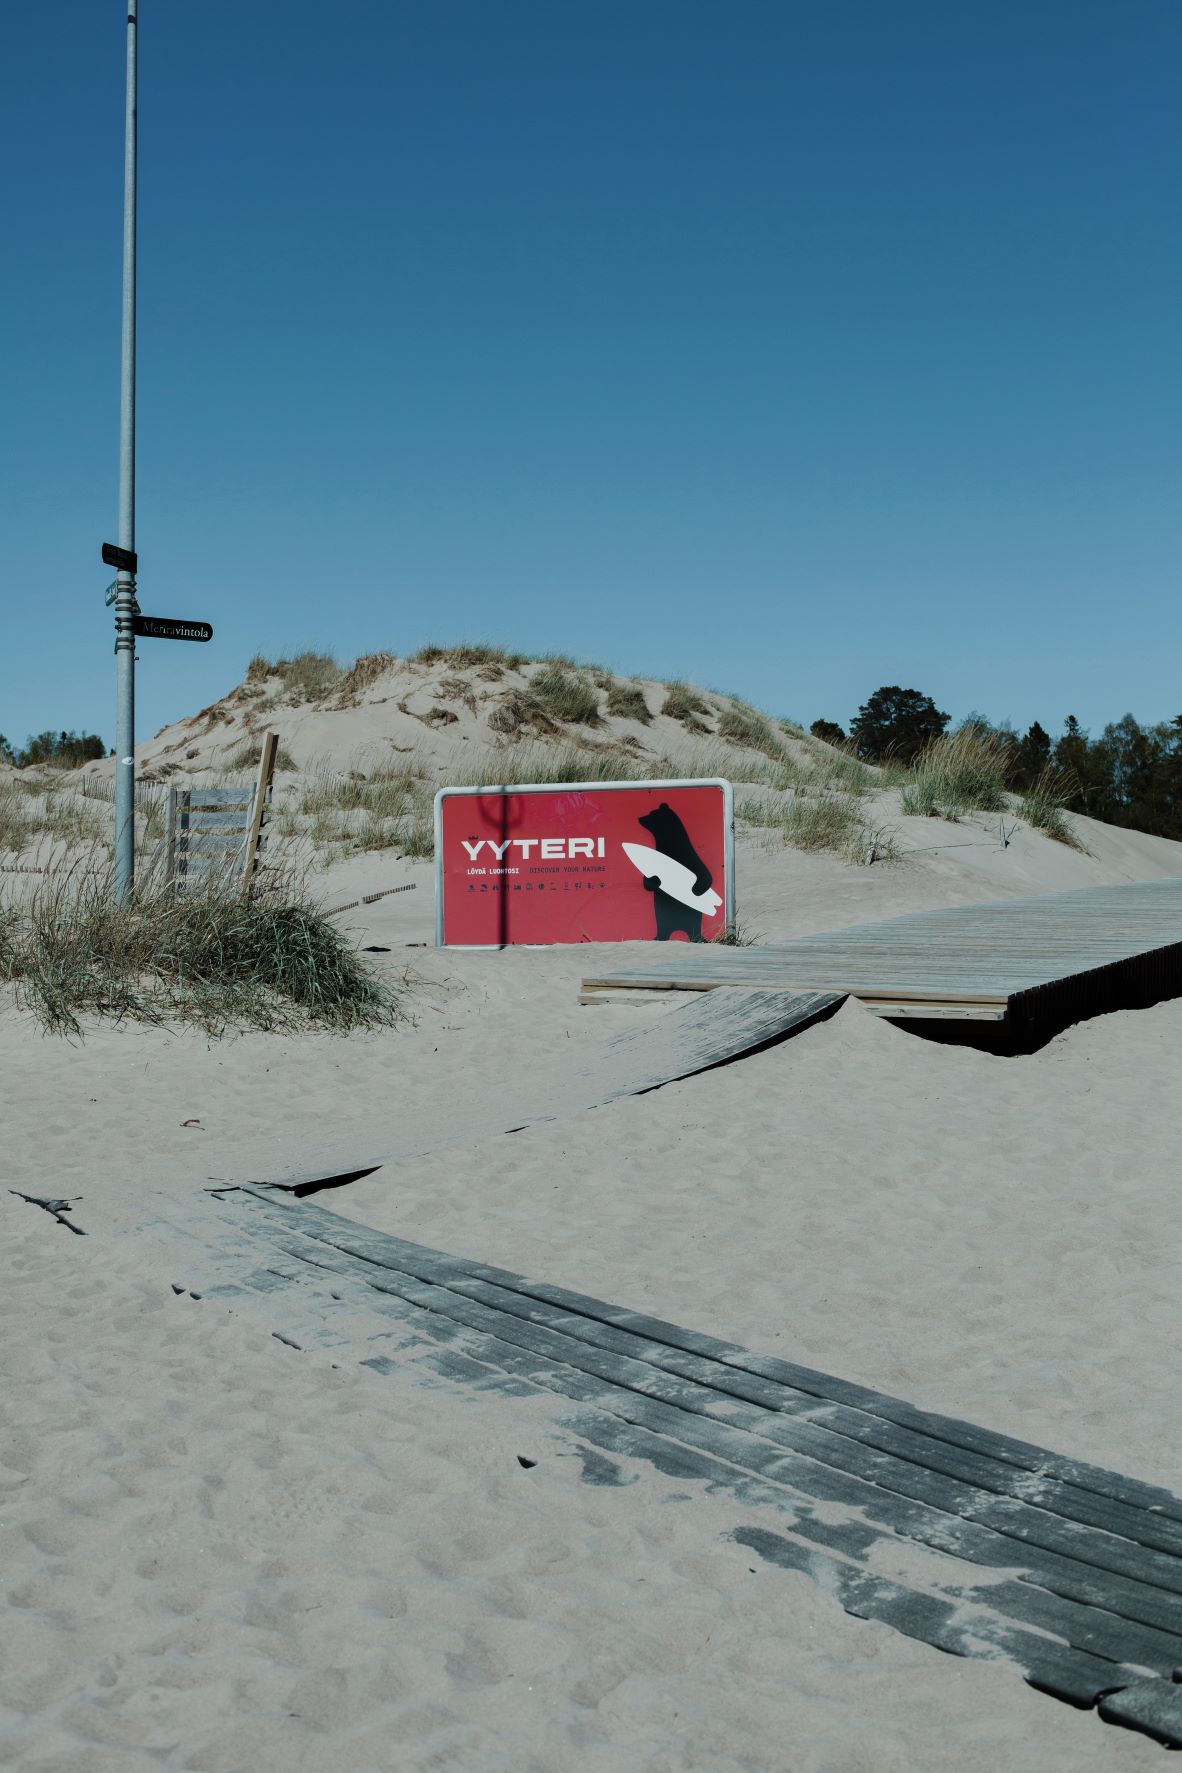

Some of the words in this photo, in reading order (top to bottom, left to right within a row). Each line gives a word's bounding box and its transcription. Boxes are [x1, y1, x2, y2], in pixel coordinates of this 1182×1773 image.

[143, 621, 209, 638] Meriravintola
[461, 837, 605, 861] YYTERI
[467, 867, 487, 875] LÖYDÄ
[489, 867, 520, 875] LUONTOSI
